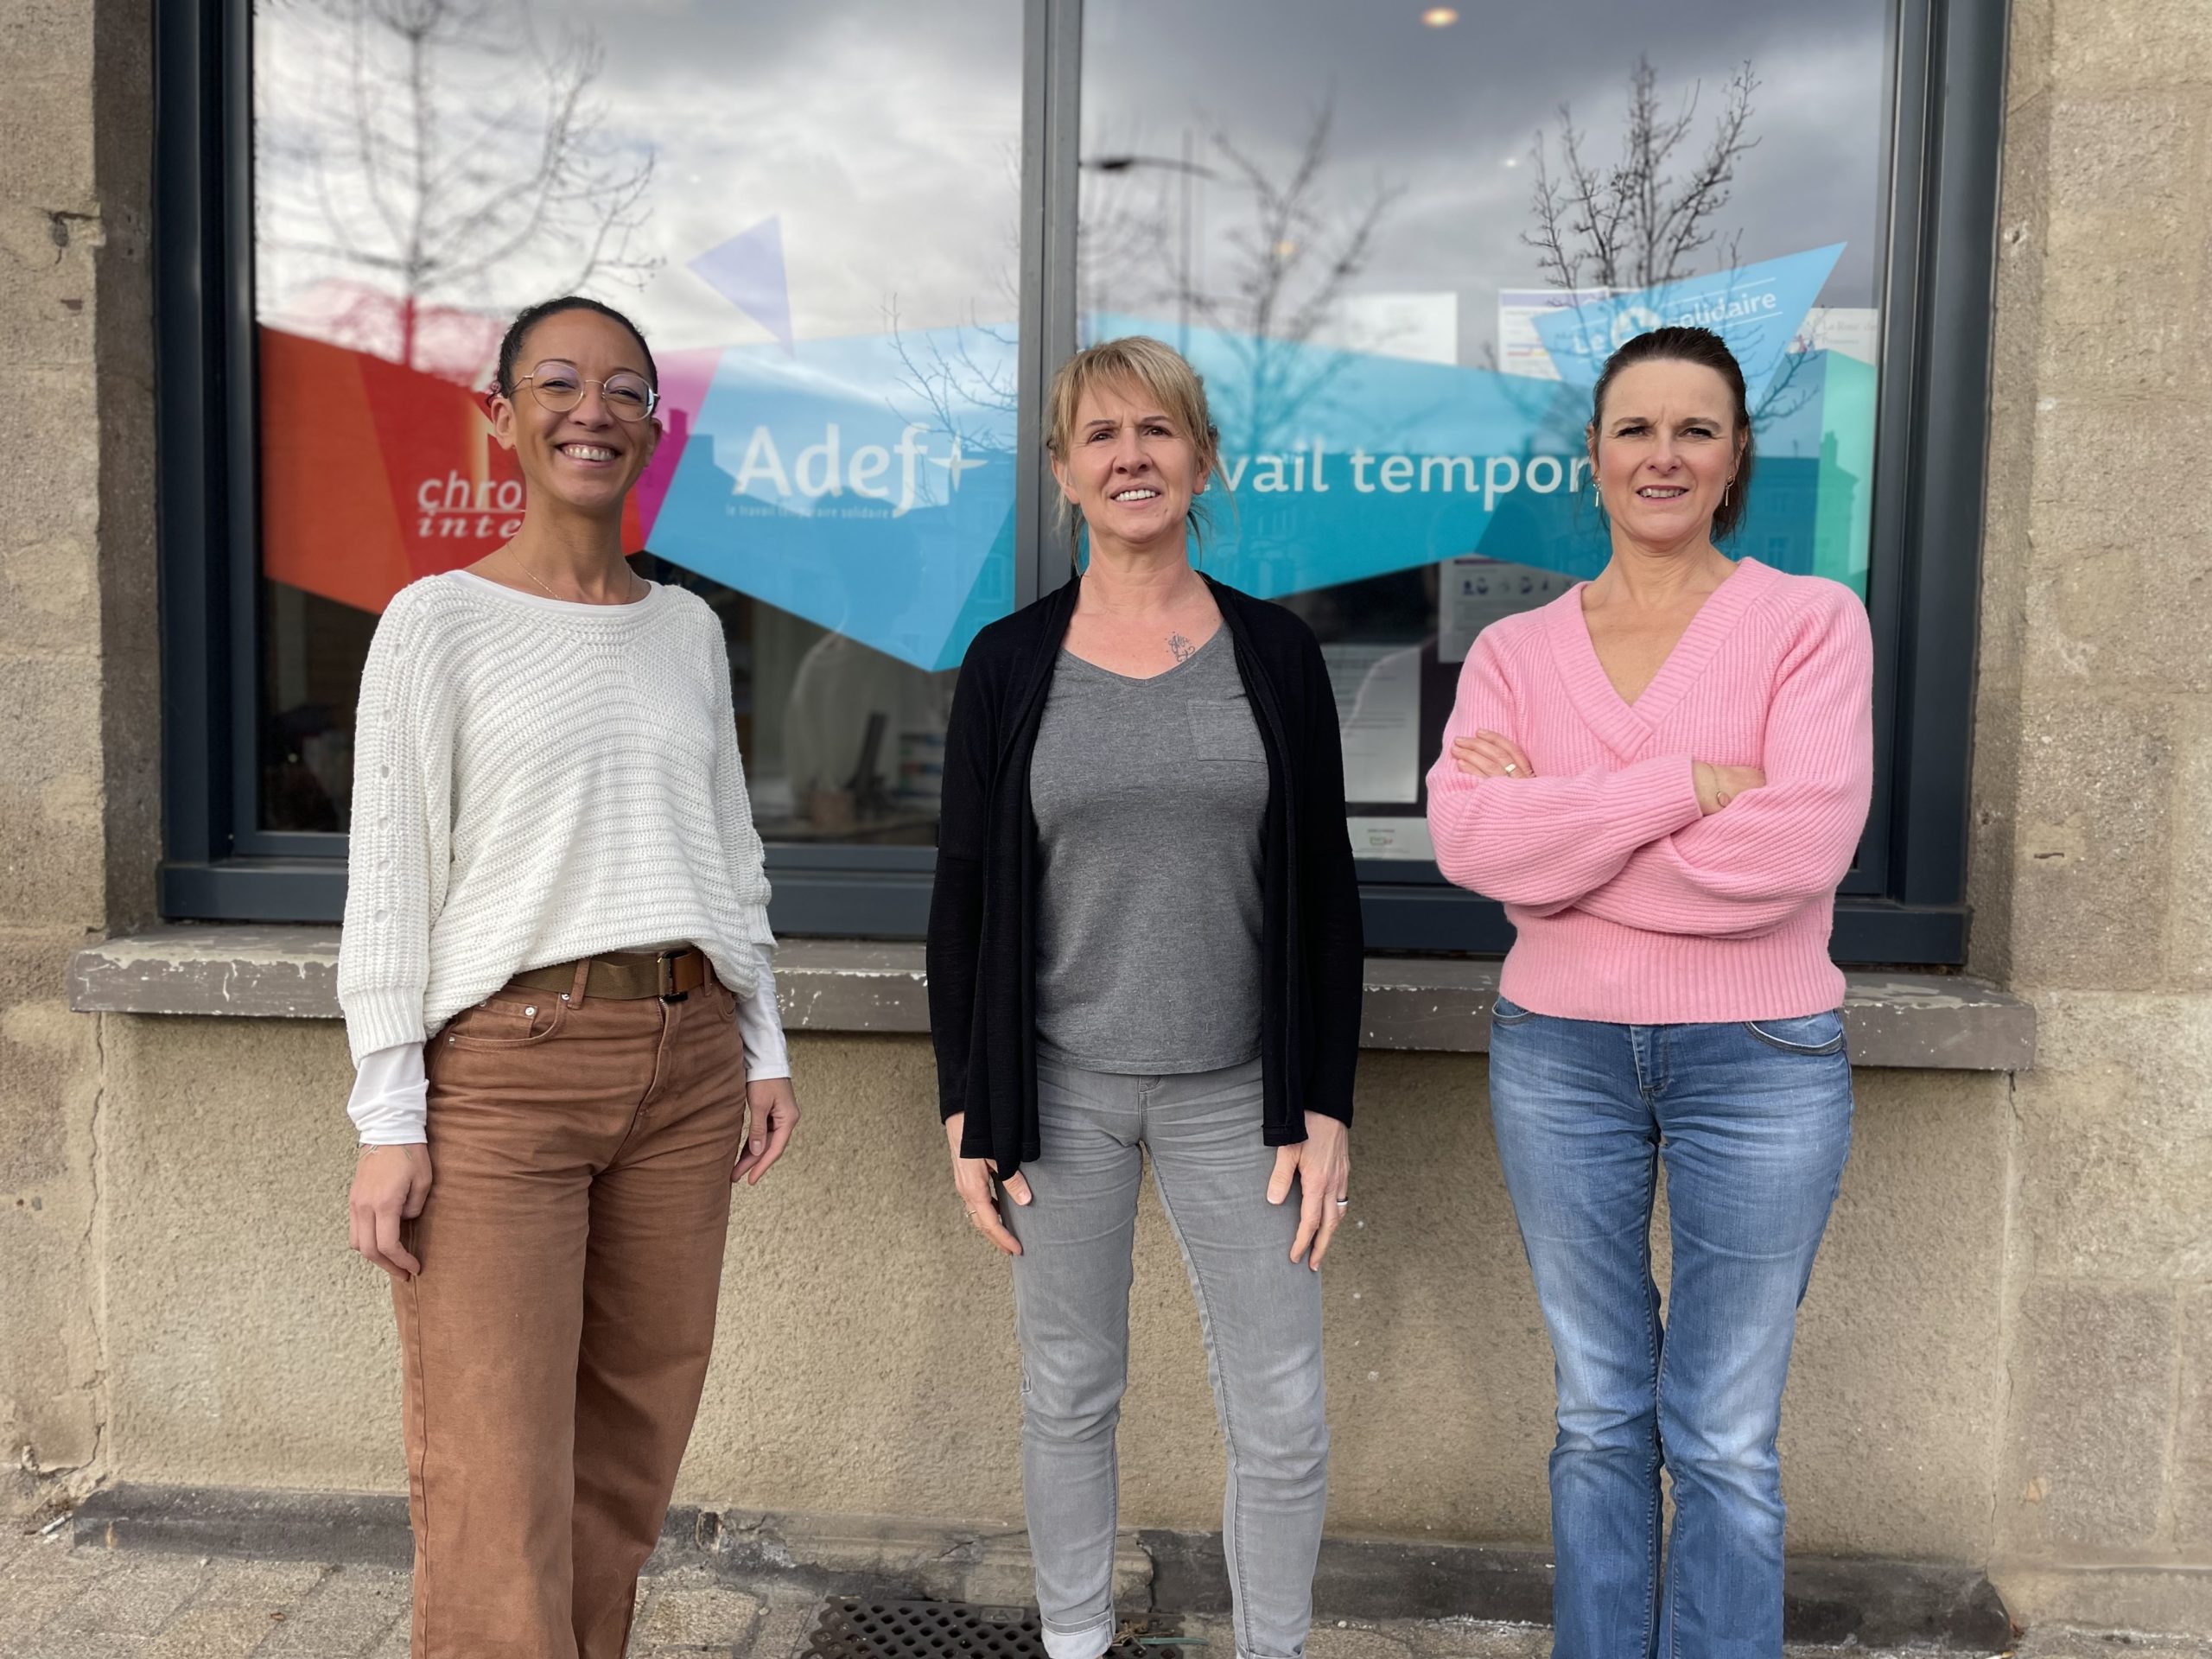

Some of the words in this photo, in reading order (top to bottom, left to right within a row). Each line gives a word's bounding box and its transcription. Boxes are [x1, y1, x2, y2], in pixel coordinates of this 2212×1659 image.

[1667, 292, 1777, 328] solidaire
[417, 469, 522, 511] chro
[1349, 447, 1591, 512] tempor
[417, 508, 521, 538] inte
